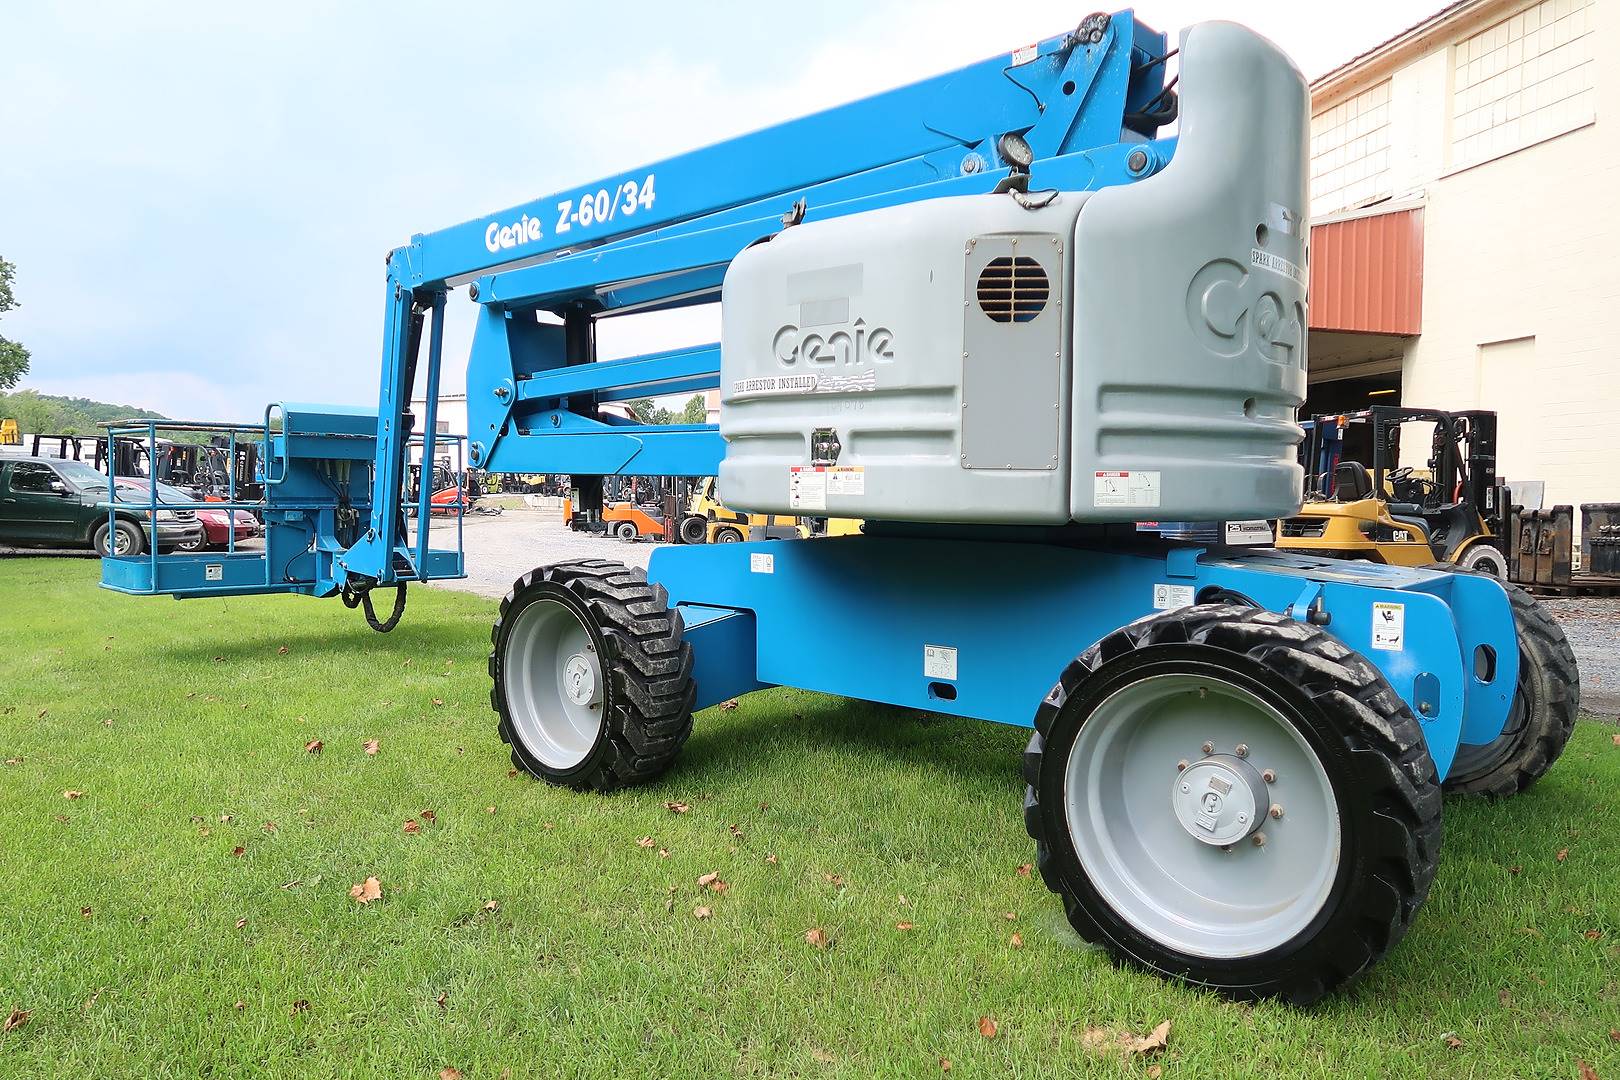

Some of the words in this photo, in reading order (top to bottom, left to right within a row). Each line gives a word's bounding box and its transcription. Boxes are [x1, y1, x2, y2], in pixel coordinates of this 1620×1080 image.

[485, 213, 542, 253] Genie
[555, 174, 656, 234] Z-60/34
[1252, 250, 1270, 267] SPARK
[772, 317, 895, 369] Genie
[745, 378, 776, 392] ARRESTOR
[778, 376, 816, 389] INSTALLED
[1229, 524, 1241, 532] 25
[1392, 530, 1408, 541] CAT
